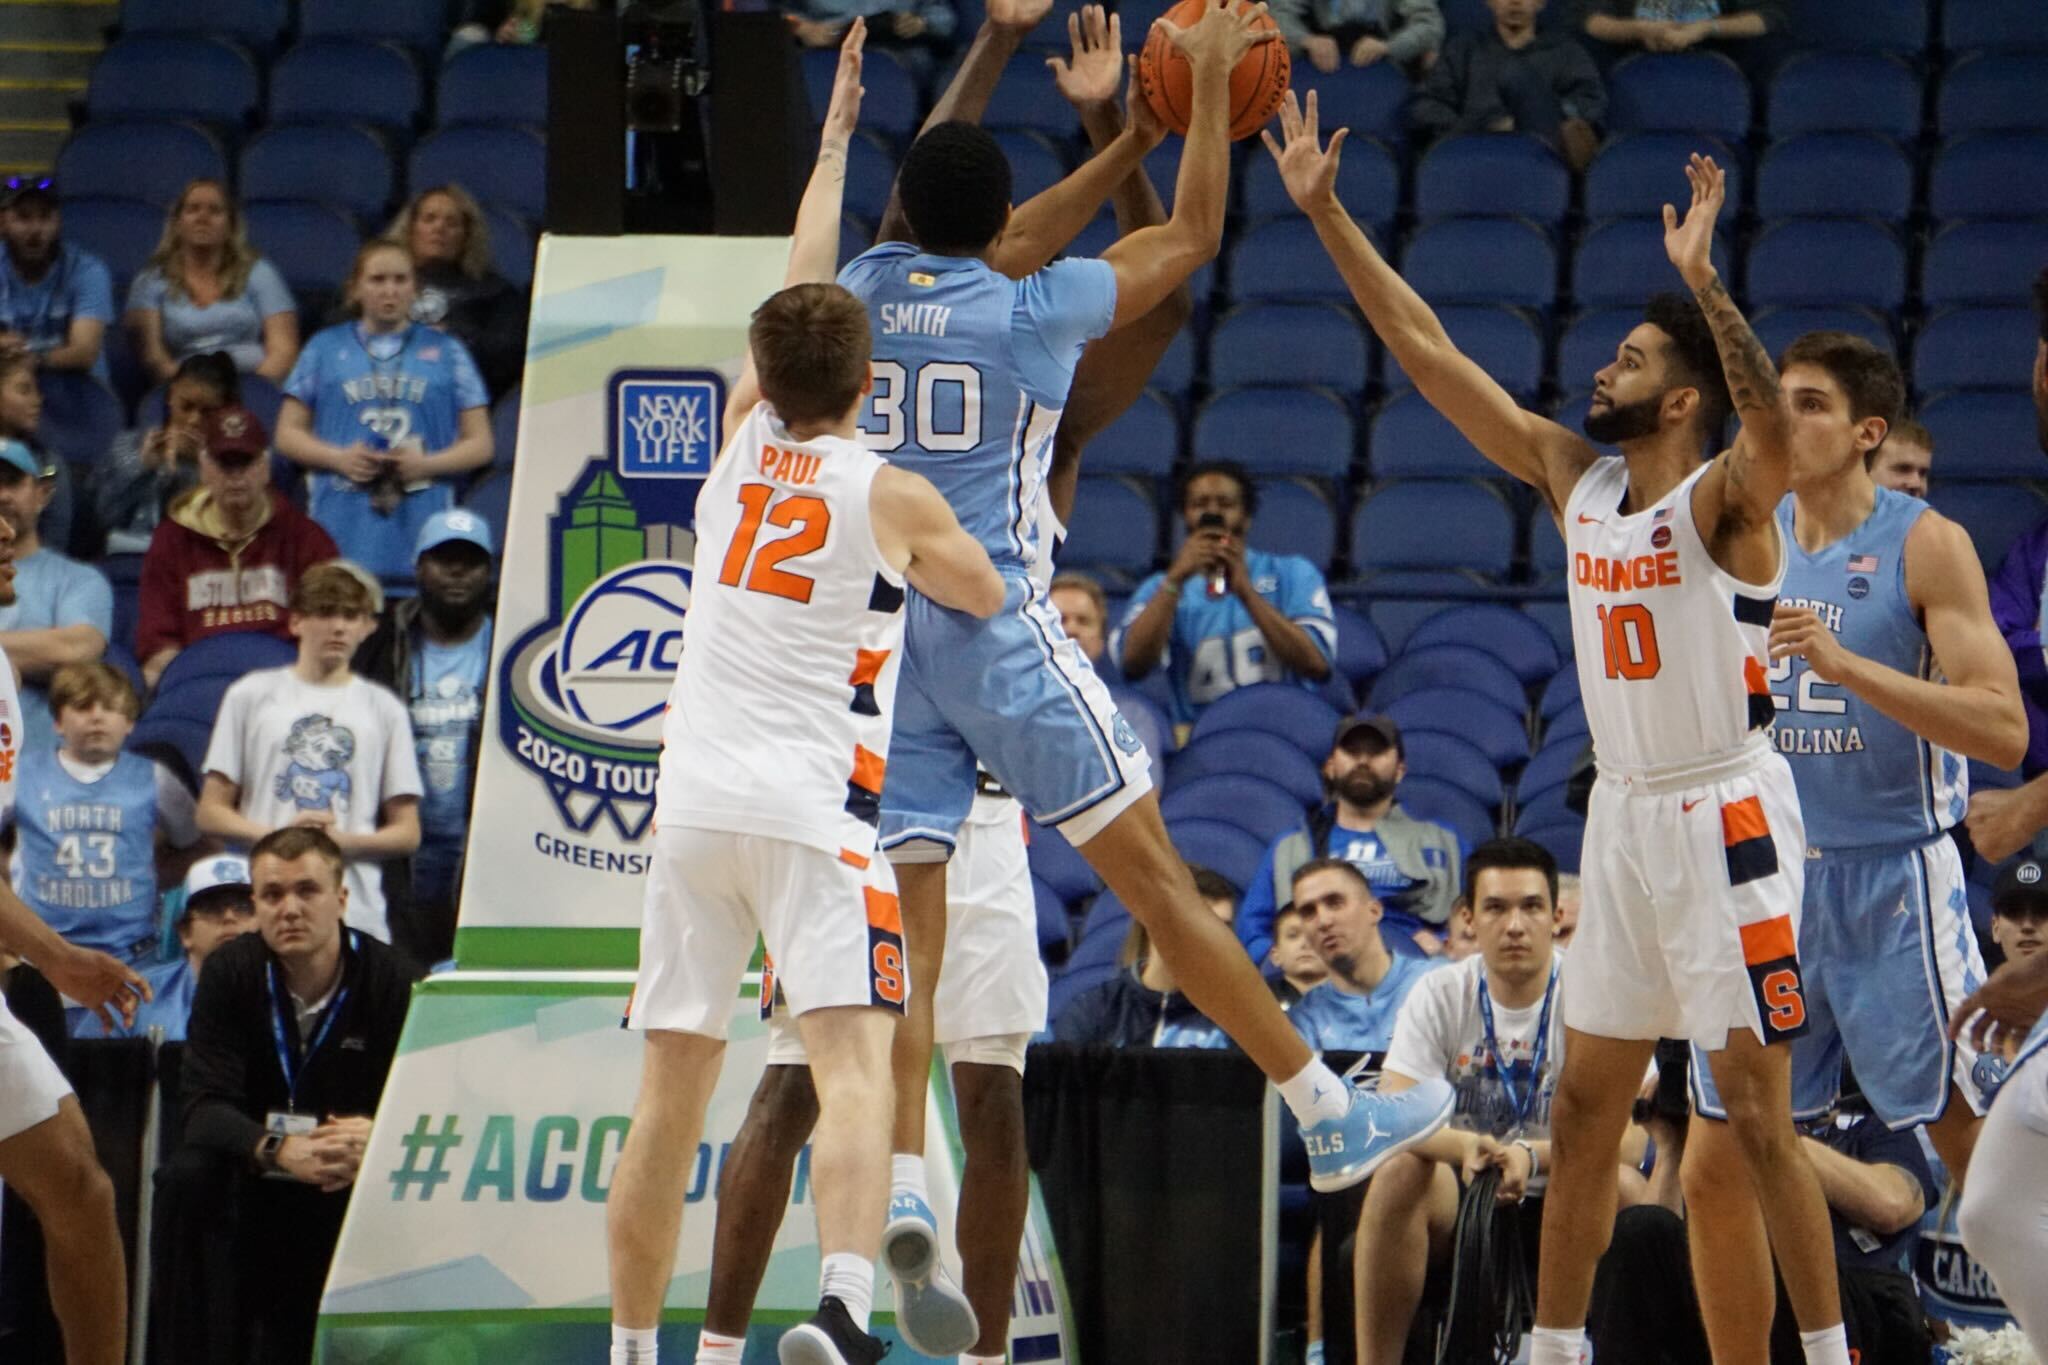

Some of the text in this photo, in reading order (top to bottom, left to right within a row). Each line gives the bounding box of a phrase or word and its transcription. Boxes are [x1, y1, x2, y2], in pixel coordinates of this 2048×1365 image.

[881, 304, 951, 337] SMITH
[638, 394, 702, 420] NEW
[865, 360, 983, 453] 30
[628, 416, 706, 443] YORK
[639, 440, 699, 464] LIFE
[759, 444, 822, 485] PAUL
[718, 483, 831, 605] 12
[1575, 551, 1682, 592] OANGE
[203, 603, 276, 628] EAGLES
[583, 629, 684, 672] AC
[1596, 603, 1662, 681] 10
[516, 726, 659, 796] 2020 TOU
[1768, 726, 1865, 755] ROLINA
[48, 805, 121, 833] NORTH
[56, 832, 115, 878] 43
[38, 876, 132, 909] CAROLINA
[872, 941, 904, 1005] S
[1762, 969, 1806, 1032] S
[388, 1114, 633, 1204] #ACC
[1304, 1131, 1344, 1156] ELS
